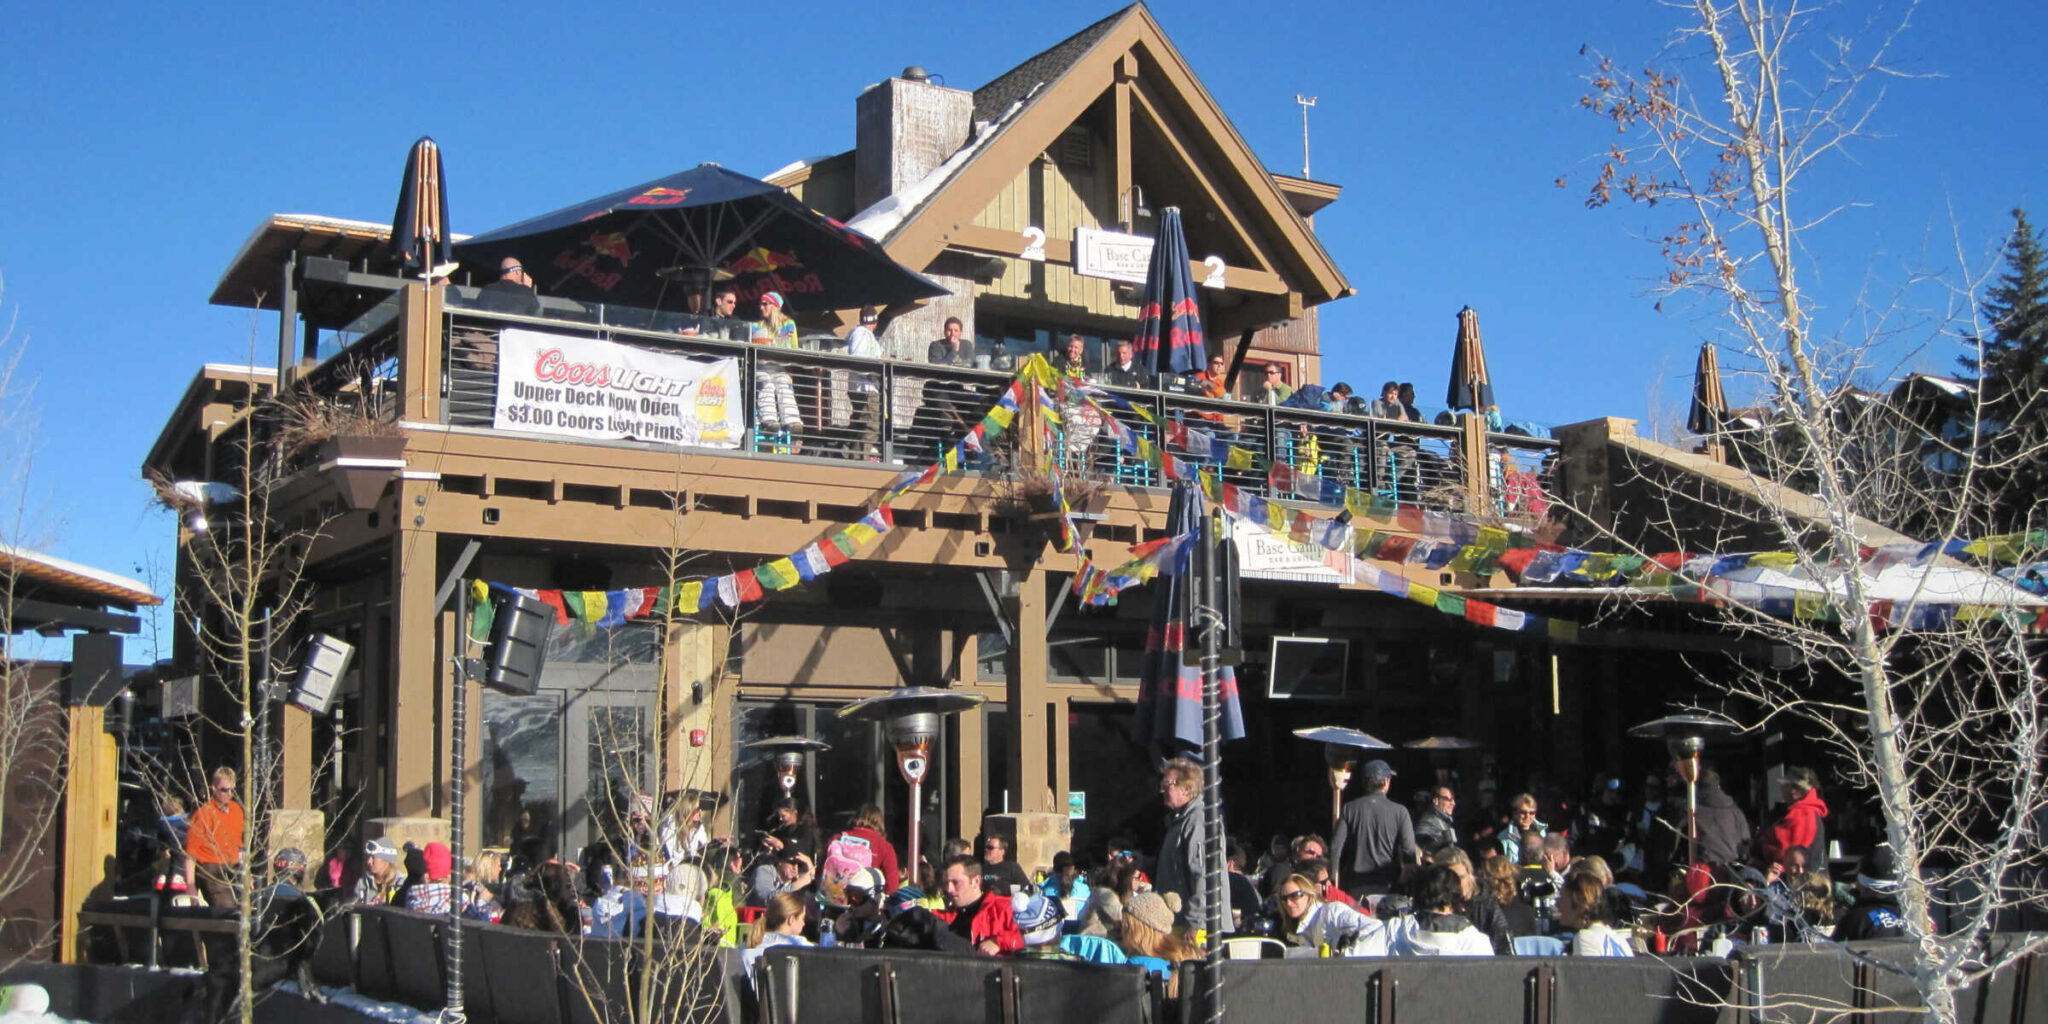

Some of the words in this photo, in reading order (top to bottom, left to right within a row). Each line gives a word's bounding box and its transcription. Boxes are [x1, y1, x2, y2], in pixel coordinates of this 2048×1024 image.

[1020, 226, 1046, 261] 2
[1106, 248, 1129, 261] Base
[1132, 248, 1151, 262] Ca
[1202, 255, 1226, 289] 2
[536, 348, 611, 388] Coors
[611, 367, 692, 397] LIGHT
[514, 381, 562, 402] Upper
[565, 387, 605, 406] Deck
[608, 392, 637, 412] Now
[640, 397, 679, 417] Open
[508, 403, 553, 425] $3.00
[557, 410, 604, 431] Coors
[608, 415, 641, 436] Light
[644, 422, 684, 441] Pints
[1256, 539, 1283, 555] Base
